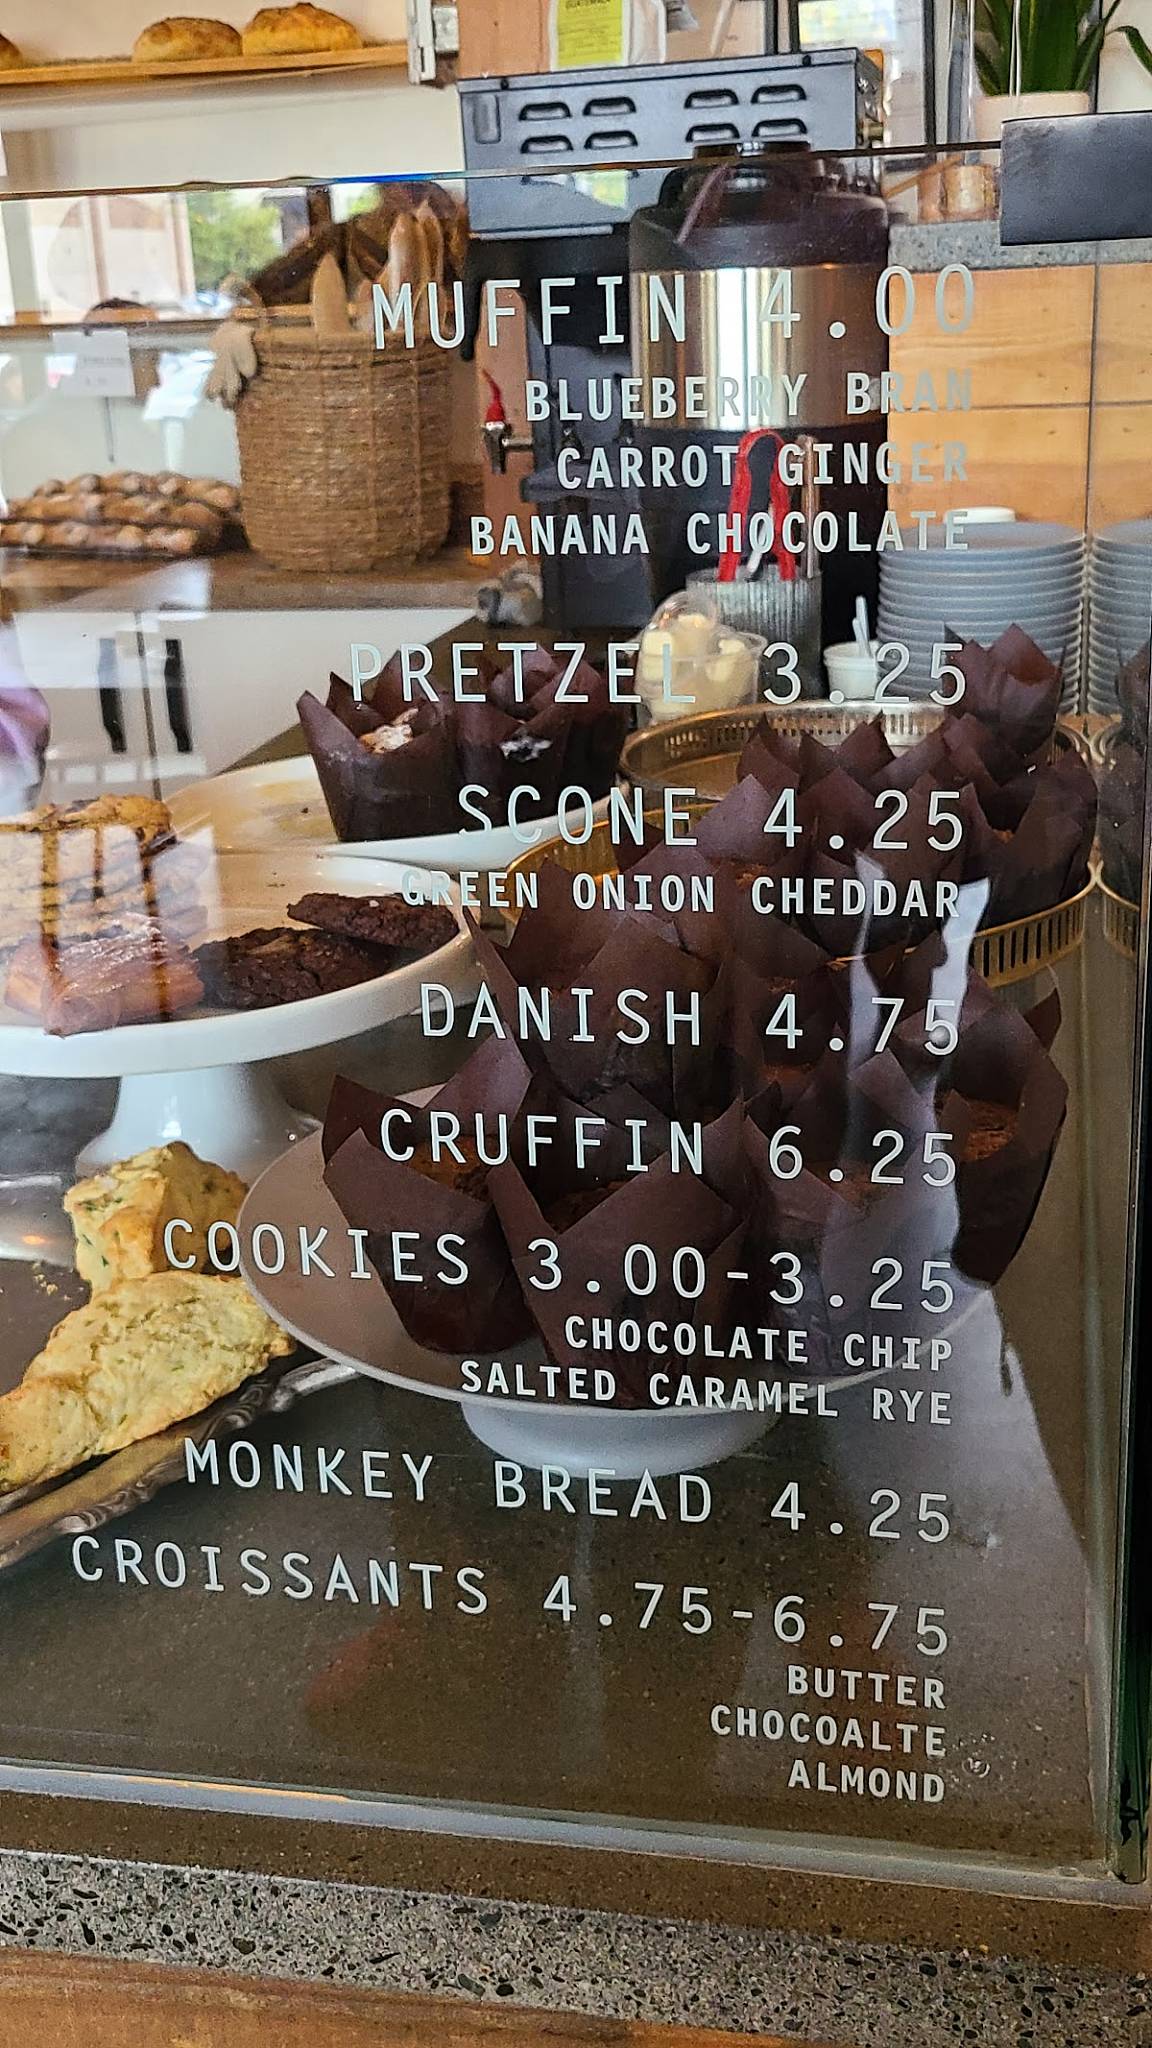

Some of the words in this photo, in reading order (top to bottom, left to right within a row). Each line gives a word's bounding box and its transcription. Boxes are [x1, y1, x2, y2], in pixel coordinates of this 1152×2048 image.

[371, 275, 686, 350] MUFFIN
[758, 264, 976, 340] 4.00
[526, 374, 808, 421] BLUEBERRY
[847, 369, 973, 412] BRAN
[557, 445, 737, 490] CARROT
[779, 442, 968, 485] GINGER
[472, 513, 650, 556] BANANA
[687, 510, 968, 554] CHOCOLATE
[351, 642, 696, 705] PRETZEL
[764, 642, 966, 706] 3.25
[458, 785, 699, 848] SCONE
[764, 788, 963, 851] 4.25
[401, 870, 538, 908] GREEN
[574, 874, 715, 914] ONION
[752, 876, 959, 918] CHEDDAR
[420, 983, 701, 1047] DANISH
[766, 993, 959, 1055] 4.75
[380, 1109, 703, 1175] CRUFFIN
[770, 1126, 956, 1187] 6.25
[163, 1219, 469, 1285] COOKIES
[528, 1238, 953, 1313] 3.00-3.25
[565, 1316, 808, 1364] CHOCOLATE
[844, 1333, 952, 1371] CHIP
[461, 1361, 616, 1401] SALTED
[649, 1373, 838, 1417] CARAMEL
[873, 1390, 951, 1424] RYE
[184, 1437, 433, 1501] MONKEY
[495, 1460, 712, 1523] BREAD
[770, 1482, 950, 1542] 4.25
[72, 1535, 488, 1615] CROISSANTS
[543, 1575, 948, 1656] 4.75-6.75
[788, 1664, 945, 1709] BUTTER
[710, 1704, 946, 1757] CHOCOALTE
[788, 1760, 945, 1802] ALMOND
